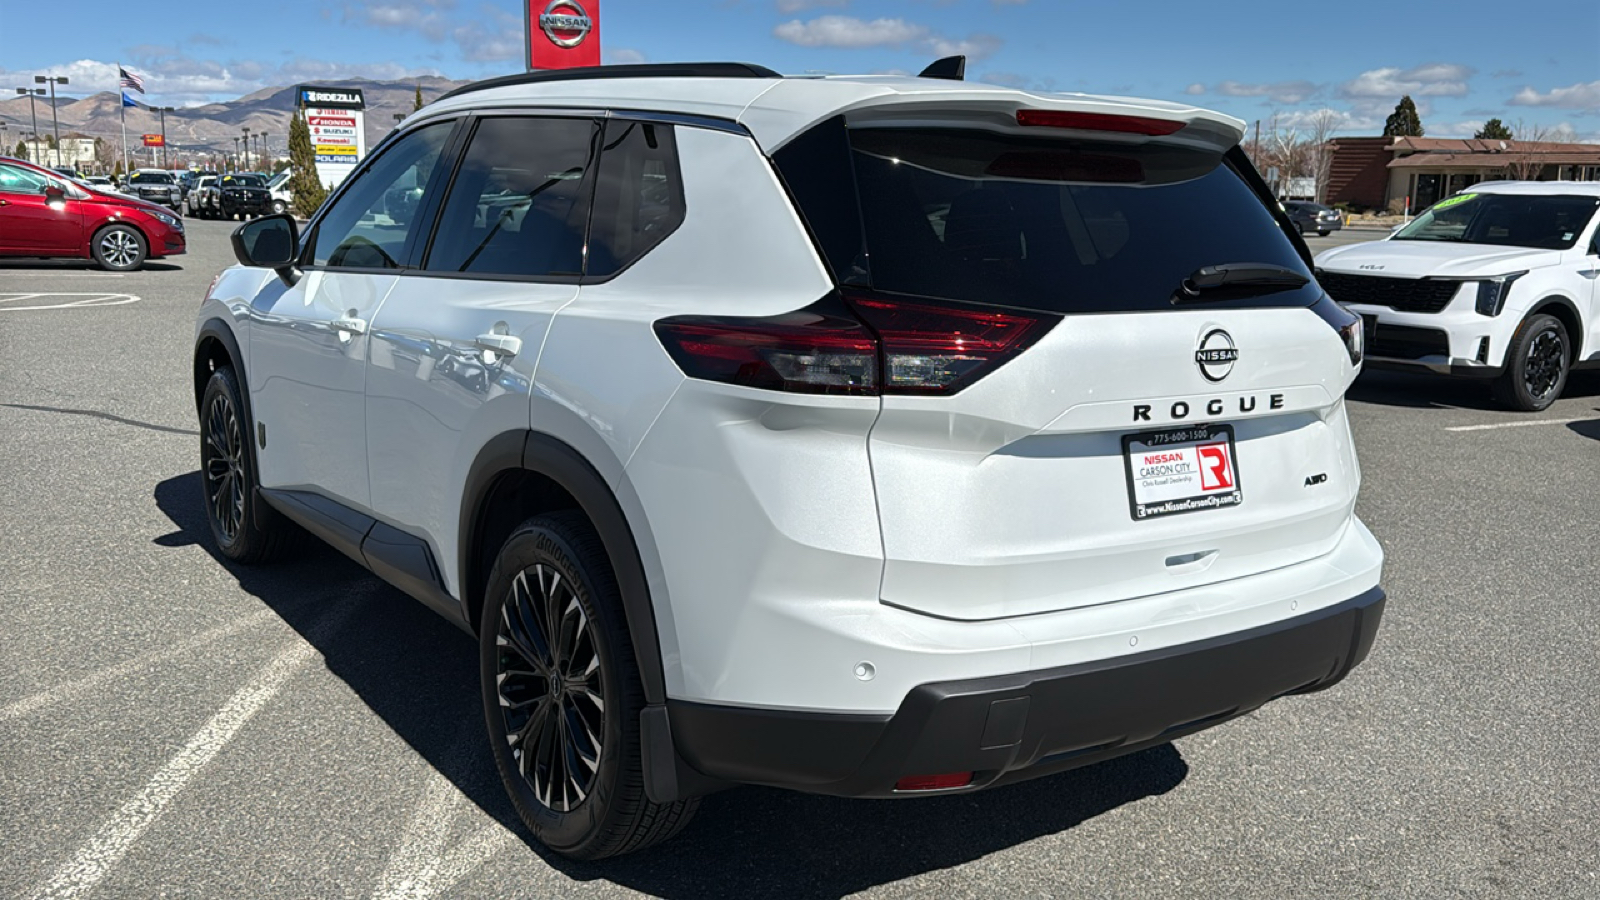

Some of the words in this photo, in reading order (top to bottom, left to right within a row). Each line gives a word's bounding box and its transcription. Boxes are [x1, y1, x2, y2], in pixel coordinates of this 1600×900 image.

[545, 17, 588, 27] NISSAN
[317, 93, 361, 103] RIDEZILLA
[1196, 350, 1238, 361] NISSAN
[1133, 394, 1285, 421] ROGUE
[1155, 430, 1208, 443] 775-600-1500
[1144, 452, 1184, 465] NISSAN
[1140, 465, 1174, 477] CARSON
[1175, 462, 1191, 472] CITY
[1155, 478, 1169, 486] Russell
[1169, 476, 1192, 485] Dealership
[1304, 473, 1328, 488] AWD
[1145, 495, 1233, 515] www.NissanCarsonCity.com
